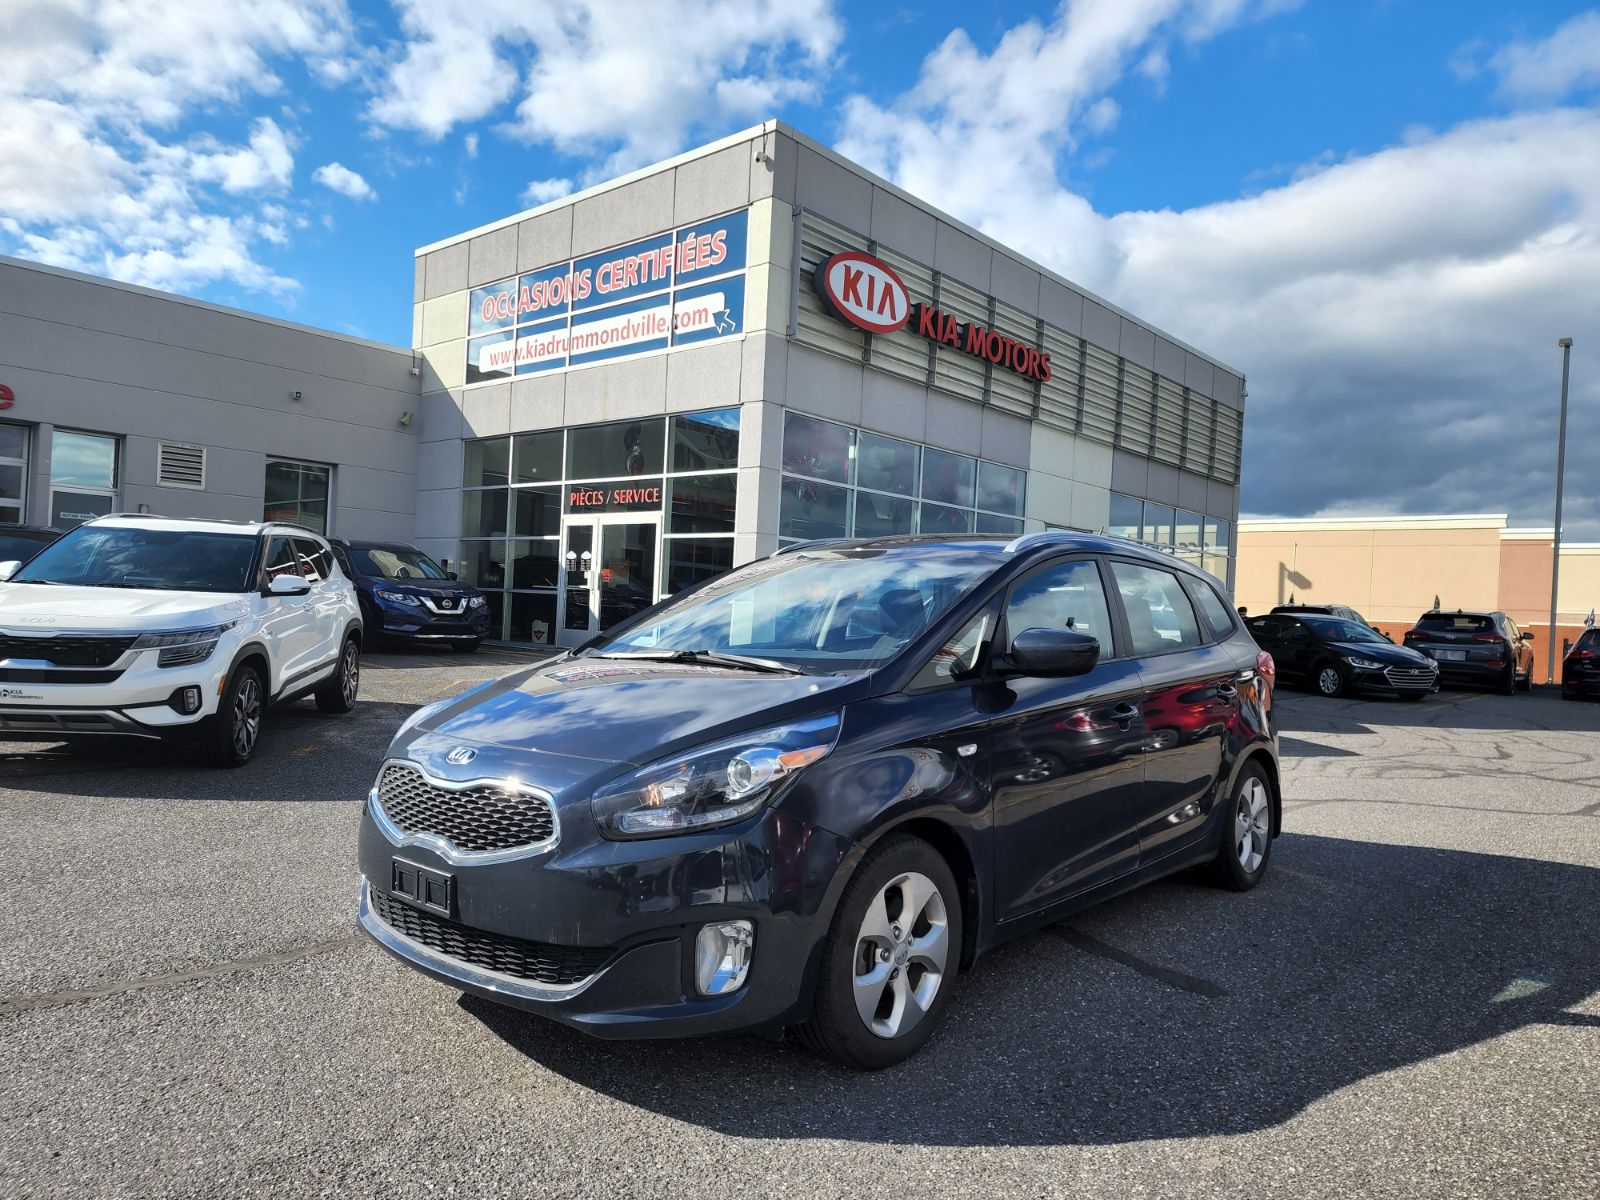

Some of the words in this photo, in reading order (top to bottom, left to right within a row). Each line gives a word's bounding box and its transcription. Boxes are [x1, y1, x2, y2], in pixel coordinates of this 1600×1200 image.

[482, 269, 592, 322] OCCASIONS
[596, 229, 728, 294] CERTIFIÉES
[842, 264, 897, 321] KIA
[490, 307, 709, 366] www.kiadrummondville.com
[919, 303, 960, 348] KIA
[967, 322, 1052, 382] MOTORS
[569, 488, 604, 506] PIÈCES
[613, 487, 660, 504] SERVICE
